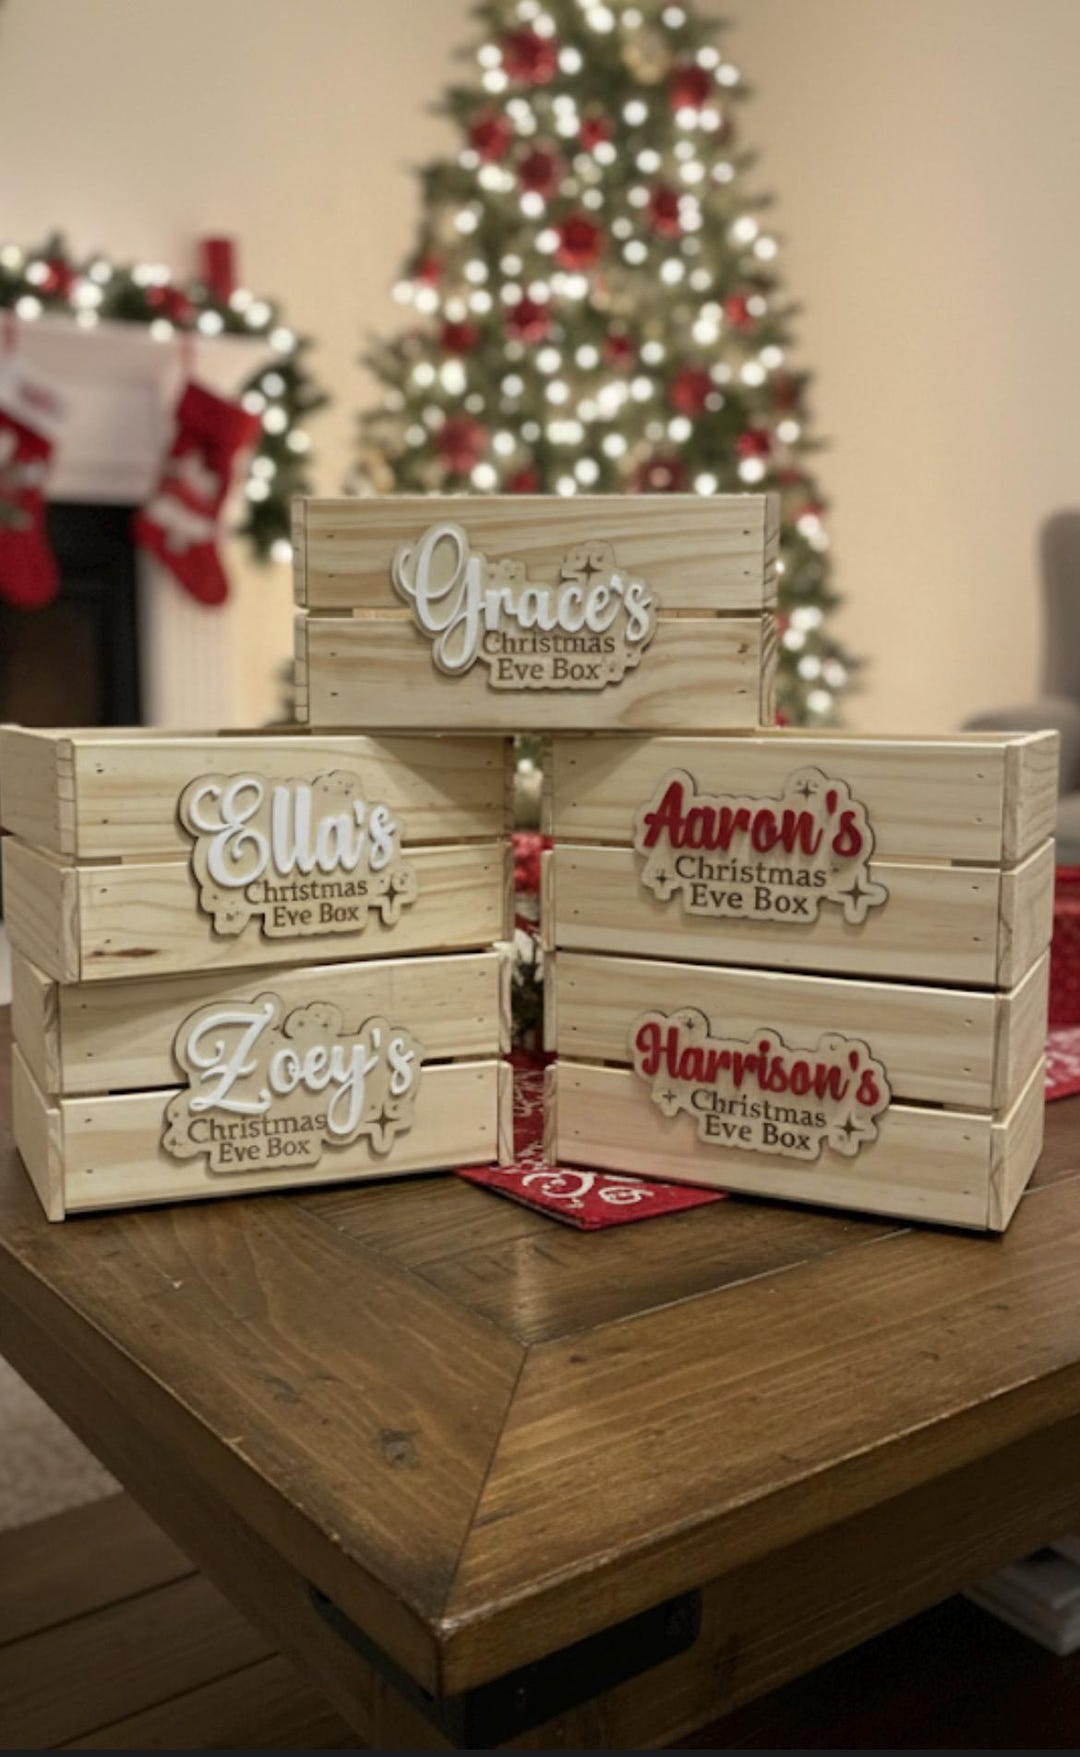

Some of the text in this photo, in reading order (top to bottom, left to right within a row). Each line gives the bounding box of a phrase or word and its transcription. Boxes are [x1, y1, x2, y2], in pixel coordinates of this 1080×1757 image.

[398, 527, 652, 668] Grace's
[482, 632, 616, 654] Christmas
[497, 657, 602, 680] Eve Box
[189, 778, 397, 888] Ella's
[643, 780, 863, 858] Aaron's
[674, 855, 827, 888] Christmas
[243, 879, 369, 904] Christmas
[690, 882, 809, 915] Eve Box
[271, 903, 360, 928] Eve Box
[187, 1002, 415, 1134] Zoey's
[635, 1021, 880, 1106] Harrison's
[690, 1088, 827, 1128] Christmas
[186, 1111, 327, 1144] Christmas
[704, 1113, 812, 1150] Eve Box
[218, 1136, 311, 1164] Eve Box
